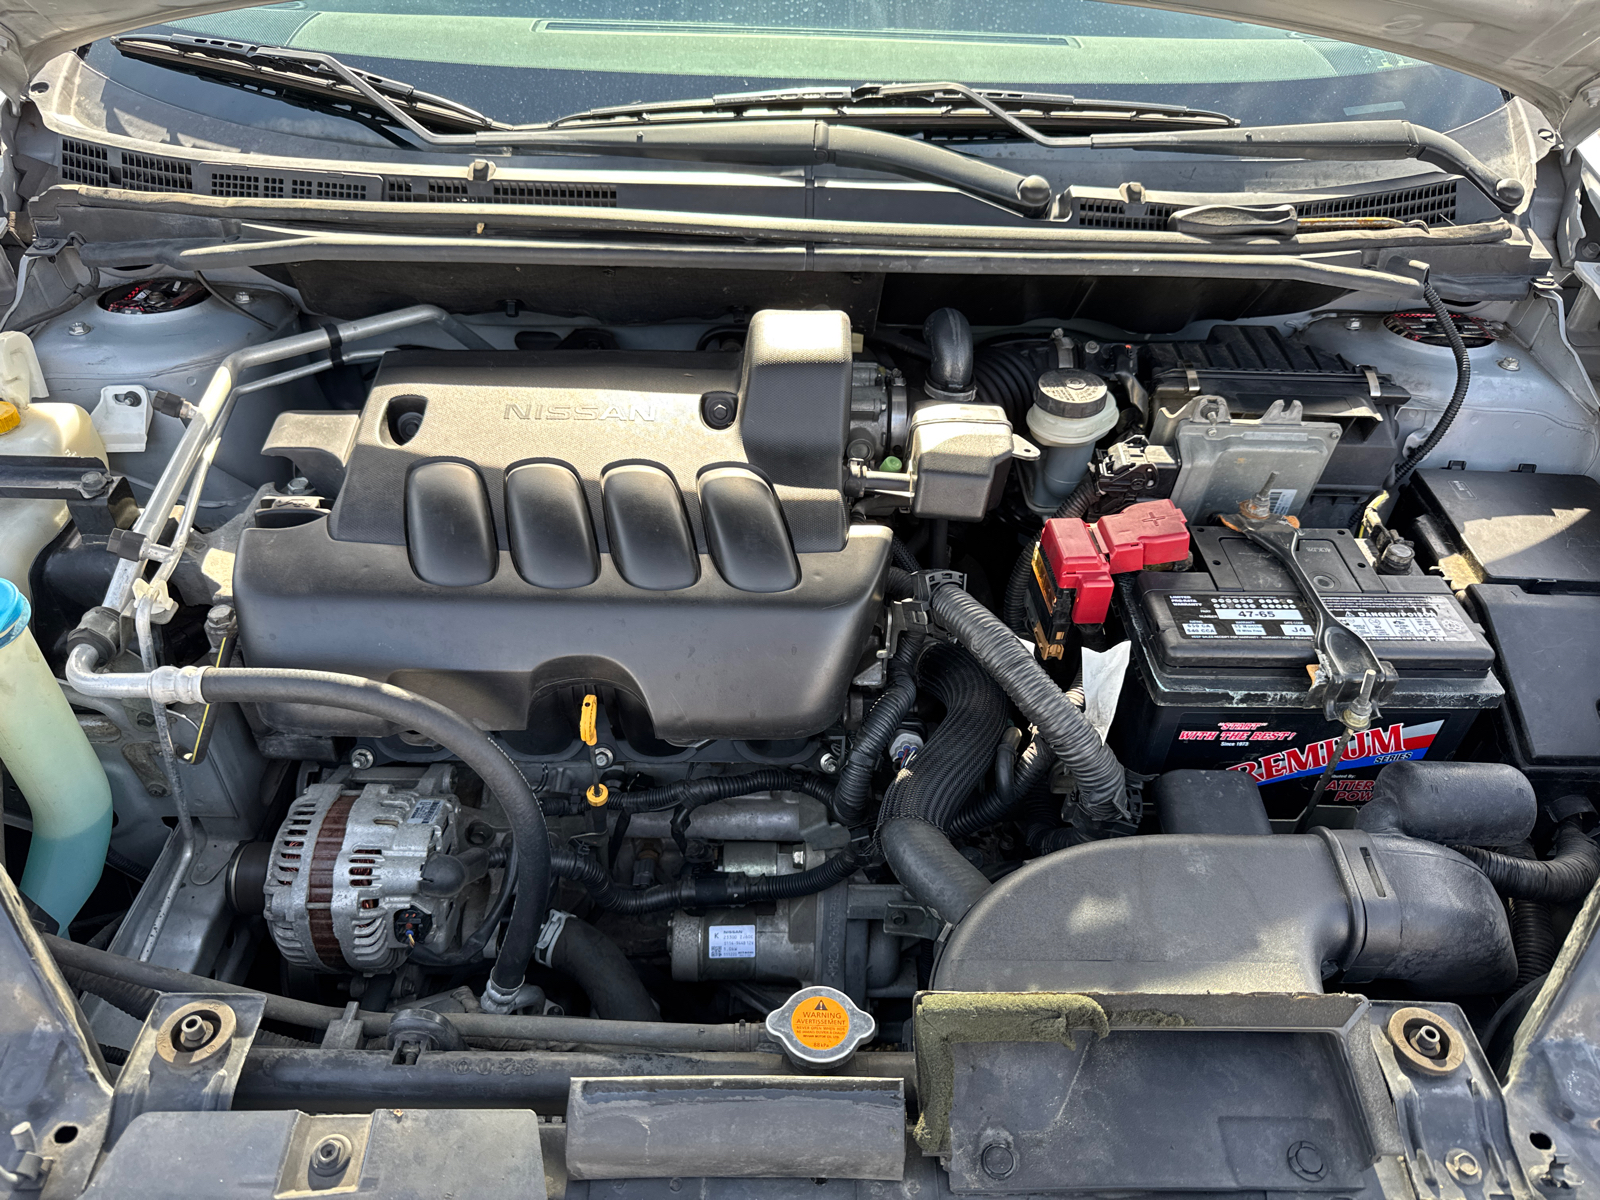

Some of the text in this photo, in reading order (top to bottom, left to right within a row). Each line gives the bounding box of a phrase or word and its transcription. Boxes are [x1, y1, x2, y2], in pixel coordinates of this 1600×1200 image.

[503, 403, 657, 422] NISSAN
[1238, 610, 1275, 618] 47-65
[1178, 731, 1298, 741] WITH THE BEST!
[1226, 722, 1413, 782] REMIUM SERIES
[1314, 779, 1376, 791] ATTER
[1333, 790, 1374, 802] POW
[802, 1011, 842, 1019] WARNING
